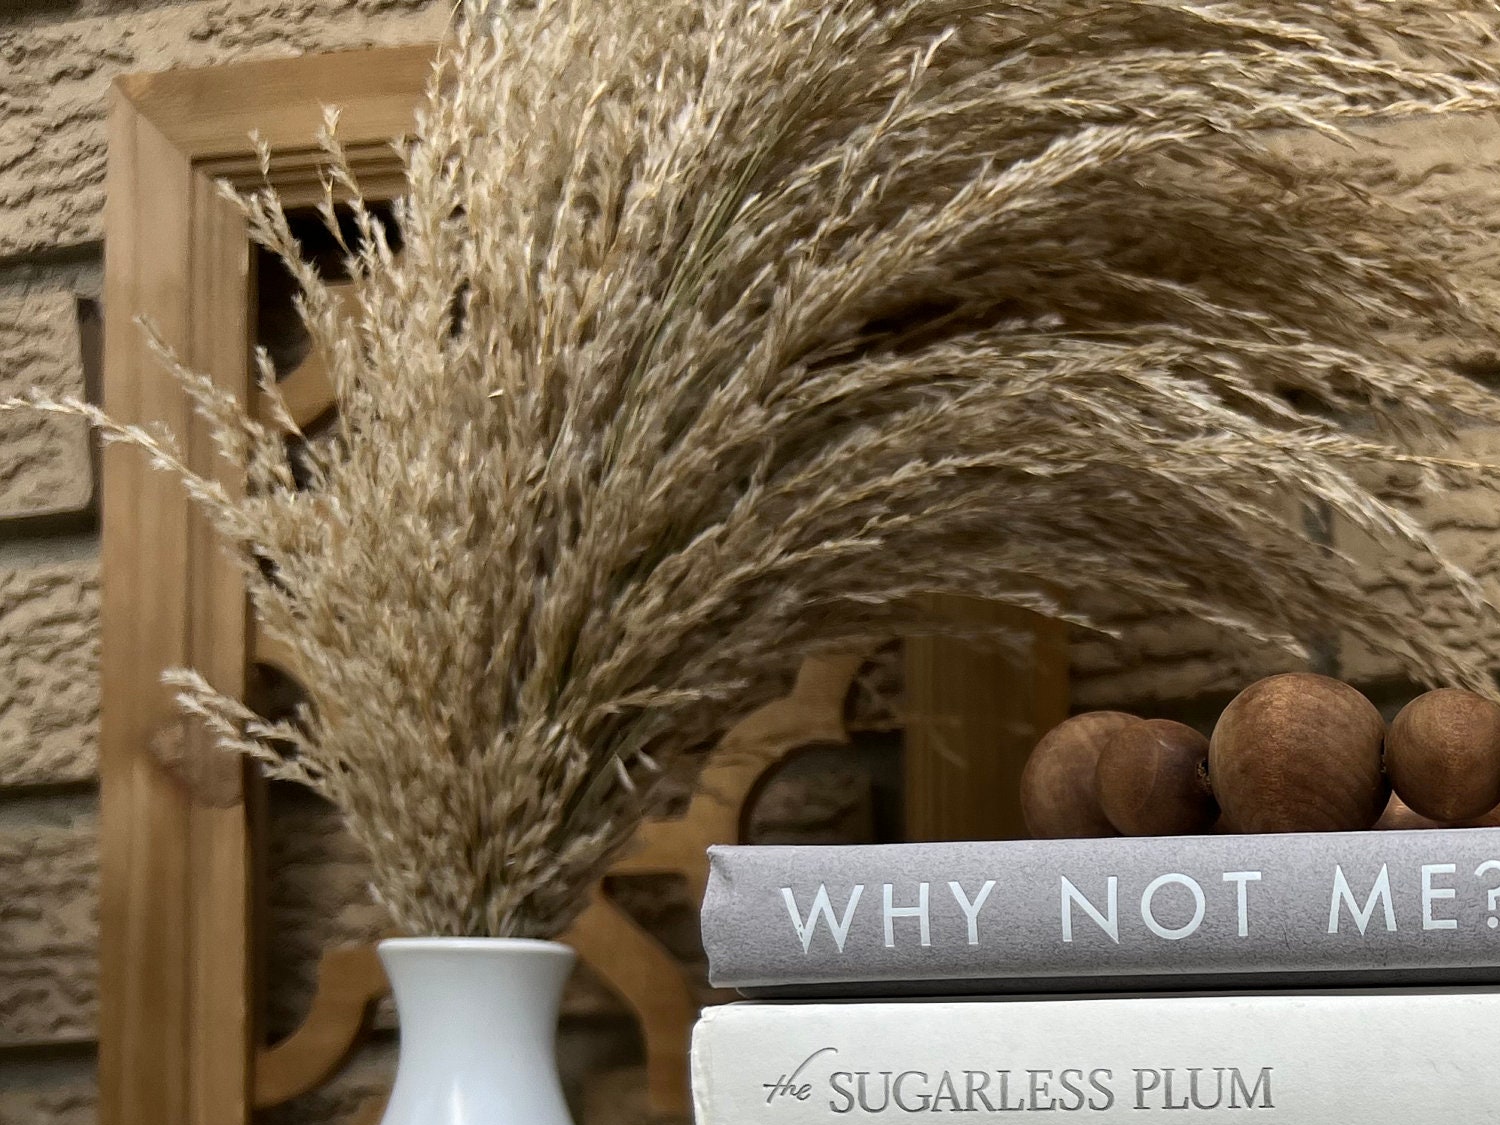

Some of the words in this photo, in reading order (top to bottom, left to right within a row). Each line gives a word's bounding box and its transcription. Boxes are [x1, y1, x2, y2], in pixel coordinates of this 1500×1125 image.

[780, 878, 998, 955] WHY
[1060, 871, 1263, 944] NOT
[763, 1047, 838, 1105] the
[829, 1068, 1114, 1115] SUGARLESS
[1132, 1066, 1275, 1111] PLUM
